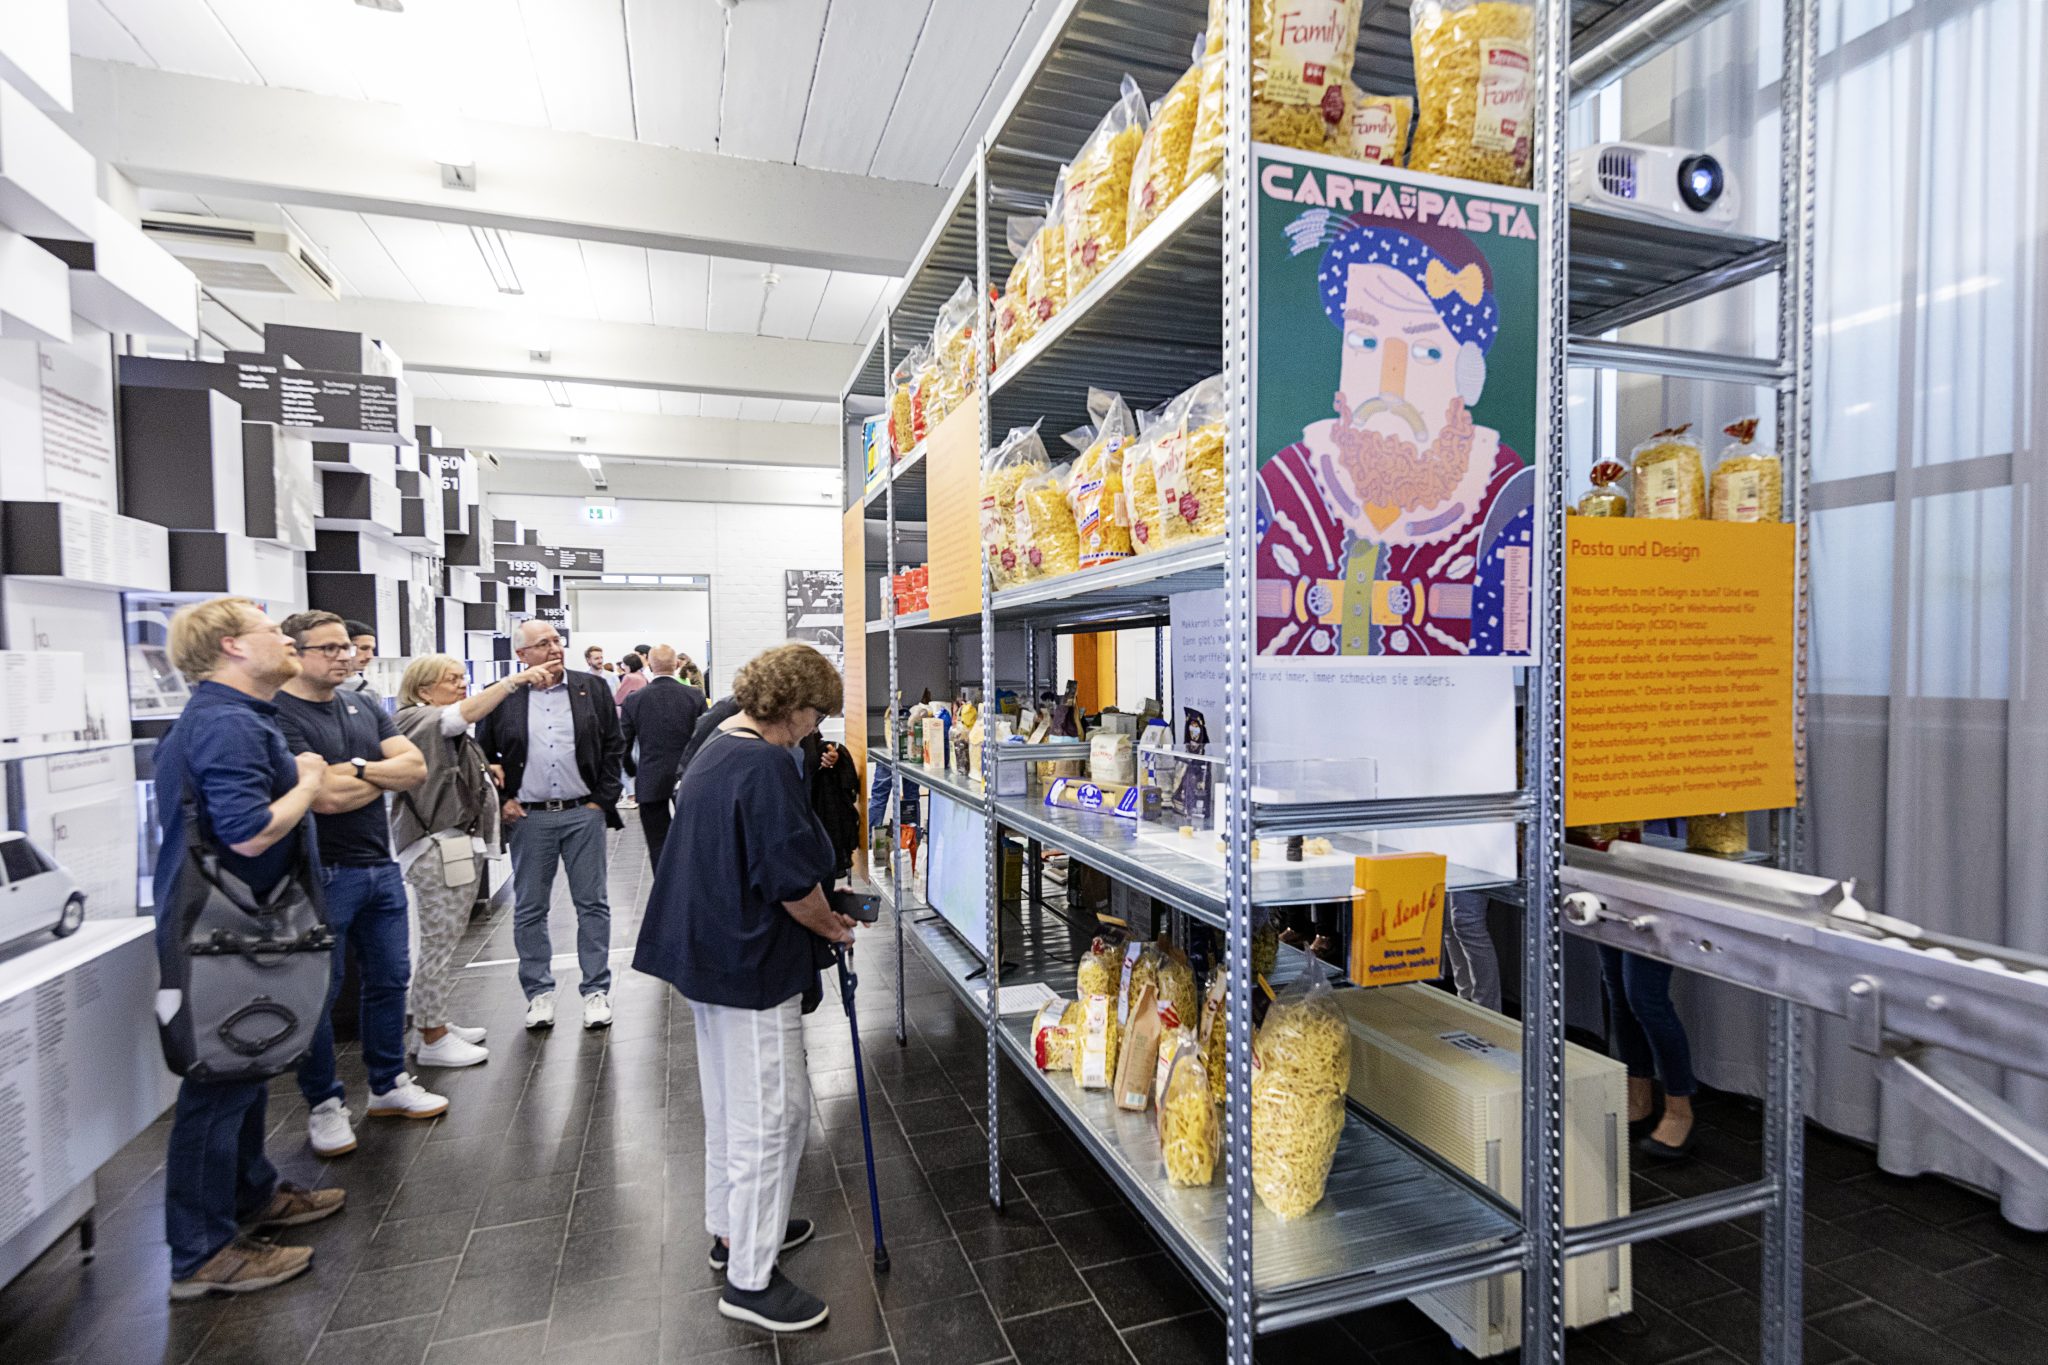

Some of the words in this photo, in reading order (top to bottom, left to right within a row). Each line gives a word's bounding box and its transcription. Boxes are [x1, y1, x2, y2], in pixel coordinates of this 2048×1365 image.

[1281, 8, 1346, 52] Family
[1352, 115, 1397, 138] Family
[1260, 163, 1404, 220] CARTA
[1417, 190, 1538, 240] PASTA
[440, 456, 459, 470] 60
[441, 477, 459, 490] 61
[1571, 539, 1614, 556] Pasta
[1619, 541, 1648, 557] und
[1651, 541, 1700, 562] Design
[508, 561, 537, 571] 1959
[507, 576, 537, 587] 1960
[1571, 587, 1592, 597] Was
[1593, 587, 1610, 597] hat
[1612, 587, 1638, 597] Pasta
[1640, 588, 1656, 597] mit
[1658, 587, 1688, 600] Design
[1690, 590, 1701, 598] zu
[1723, 588, 1742, 598] Und
[1743, 590, 1759, 598] was
[1571, 604, 1583, 613] ist
[1585, 604, 1629, 616] eigentlich
[1632, 603, 1667, 616] Design?
[1669, 603, 1686, 613] Der
[1687, 604, 1742, 614] Weltverband
[1743, 603, 1756, 613] für
[1571, 620, 1613, 630] Industrial
[1616, 619, 1646, 632] Design
[1647, 637, 1658, 646] ist
[1659, 638, 1678, 646] eine
[1184, 652, 1197, 662] sind
[1571, 654, 1585, 664] die
[1587, 653, 1618, 664] darauf
[1656, 653, 1670, 663] die
[1671, 652, 1712, 662] formalen
[1713, 651, 1759, 661] Qualitäten
[1269, 672, 1282, 682] und
[1285, 672, 1309, 683] immer,
[1313, 672, 1336, 683] immer
[1340, 672, 1387, 685] schmecken
[1391, 673, 1408, 686] sie
[1413, 673, 1456, 687] anders.
[1571, 672, 1587, 682] der
[1588, 673, 1605, 681] von
[1607, 671, 1623, 681] der
[1625, 670, 1664, 680] Industrie
[1666, 668, 1723, 681] hergestellten
[1571, 690, 1582, 699] zu
[1645, 685, 1673, 696] Damit
[1676, 684, 1687, 694] ist
[1688, 684, 1712, 694] Pasta
[1714, 684, 1730, 693] das
[1571, 703, 1606, 717] beispiel
[1607, 701, 1658, 713] schlechthin
[1659, 701, 1673, 711] für
[1674, 700, 1688, 711] ein
[1689, 699, 1729, 712] Erzeugnis
[1731, 698, 1745, 708] der
[1571, 720, 1648, 734] Massenfertigung
[1658, 718, 1682, 728] nicht
[1683, 717, 1700, 727] erst
[1702, 716, 1718, 726] seit
[1719, 714, 1738, 725] dem
[1740, 714, 1769, 726] Beginn
[1571, 738, 1588, 749] der
[1669, 734, 1703, 744] sondern
[1706, 732, 1730, 742] schon
[1732, 731, 1747, 740] seit
[1571, 753, 1609, 765] hundert
[1612, 754, 1645, 764] Jahren.
[1647, 750, 1665, 761] Seit
[1666, 749, 1687, 760] dem
[1688, 747, 1734, 758] Mittelalter
[1735, 746, 1754, 756] wird
[1572, 772, 1600, 783] Pasta
[1601, 770, 1629, 781] durch
[1631, 765, 1681, 778] industrielle
[1683, 763, 1726, 774] Methoden
[1729, 763, 1737, 771] in
[1573, 788, 1611, 802] Mengen
[1613, 784, 1631, 796] und
[1631, 781, 1680, 796] unzähligen
[1683, 780, 1716, 792] Formen
[1384, 949, 1404, 959] Bitte
[1406, 946, 1426, 955] nach
[1368, 961, 1408, 973] Gebrauch
[1409, 957, 1439, 968] zurück!
